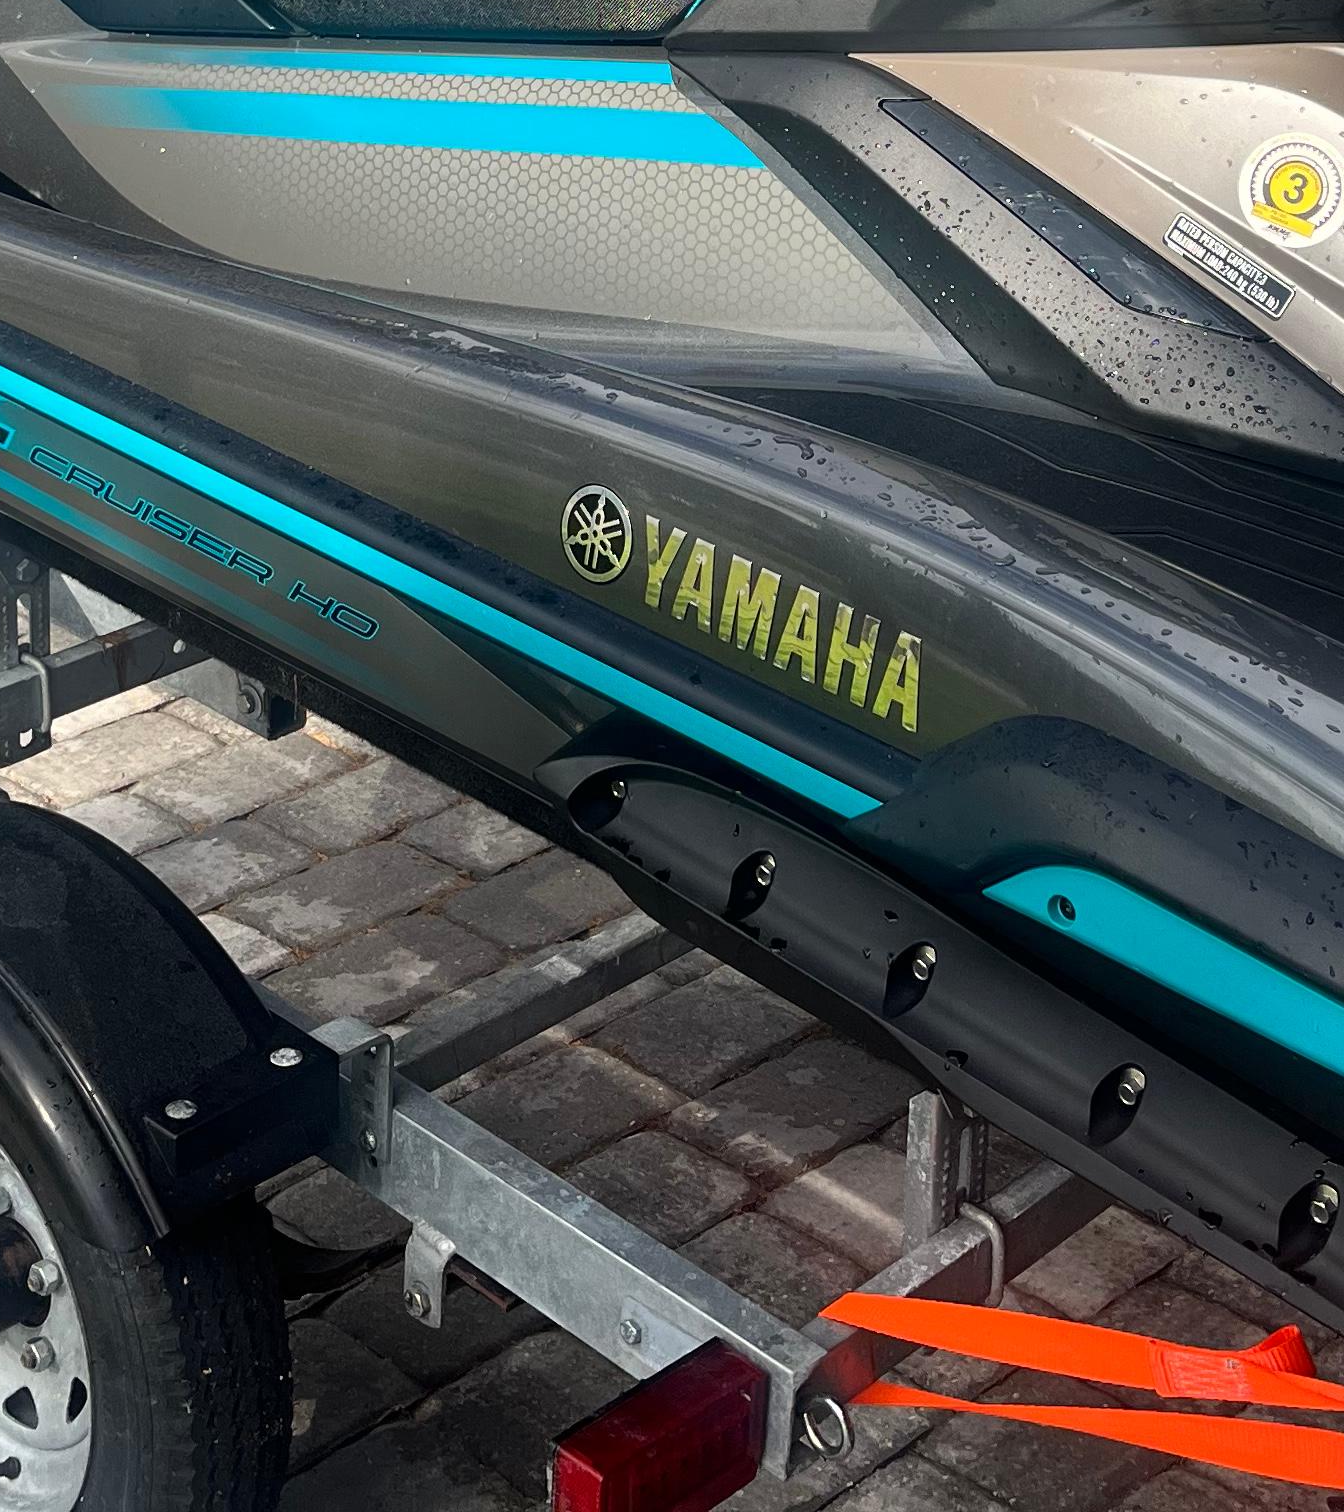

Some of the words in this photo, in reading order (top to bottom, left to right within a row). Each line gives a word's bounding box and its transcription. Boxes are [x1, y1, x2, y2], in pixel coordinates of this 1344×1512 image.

[1283, 173, 1309, 204] 3
[1169, 229, 1206, 259] MAXIMUM
[1176, 217, 1202, 241] RATED
[1198, 232, 1229, 259] PERSON
[28, 445, 275, 587] CRUISER
[286, 581, 380, 640] HO
[644, 513, 923, 734] YAMAHA
